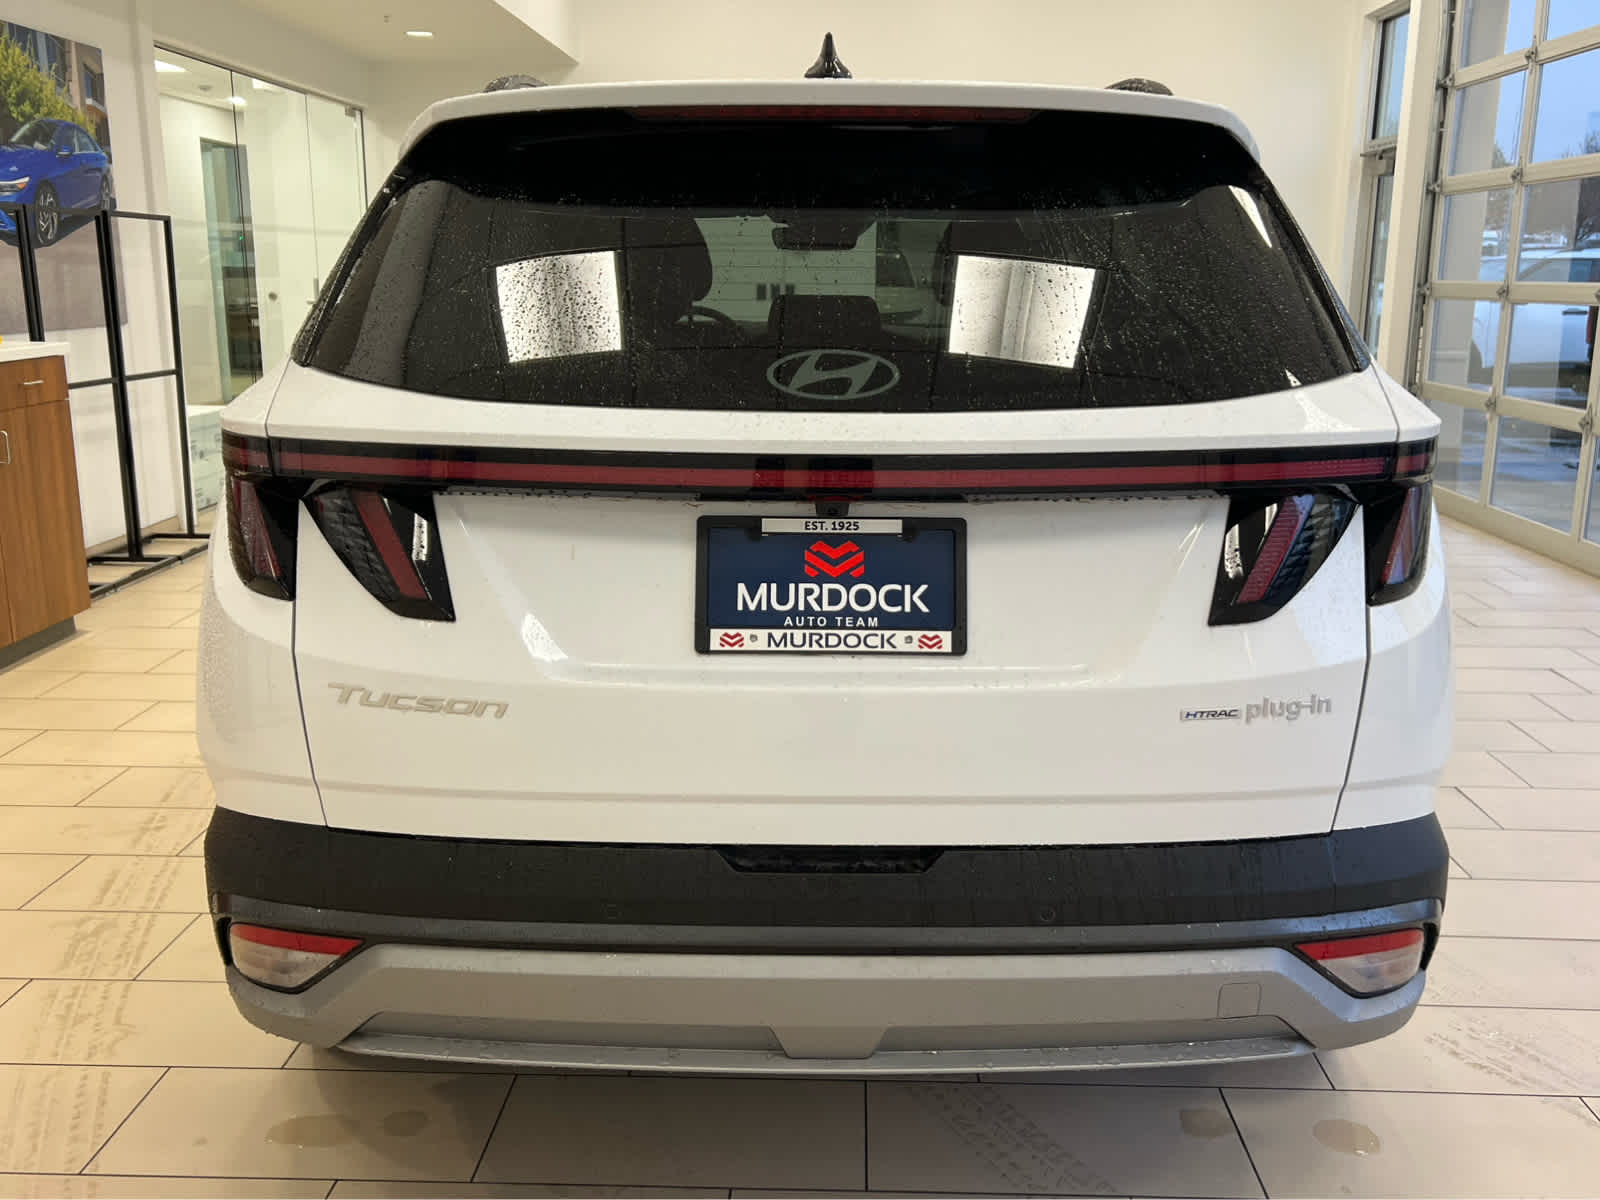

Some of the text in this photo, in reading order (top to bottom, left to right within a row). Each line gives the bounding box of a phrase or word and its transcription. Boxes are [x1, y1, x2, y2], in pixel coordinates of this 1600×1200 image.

[804, 521, 860, 531] EST. 1925
[737, 582, 930, 613] MURDOCK
[784, 616, 879, 628] AUTO TEAM
[767, 632, 897, 649] MURDOCK
[1185, 709, 1239, 719] HTRAC
